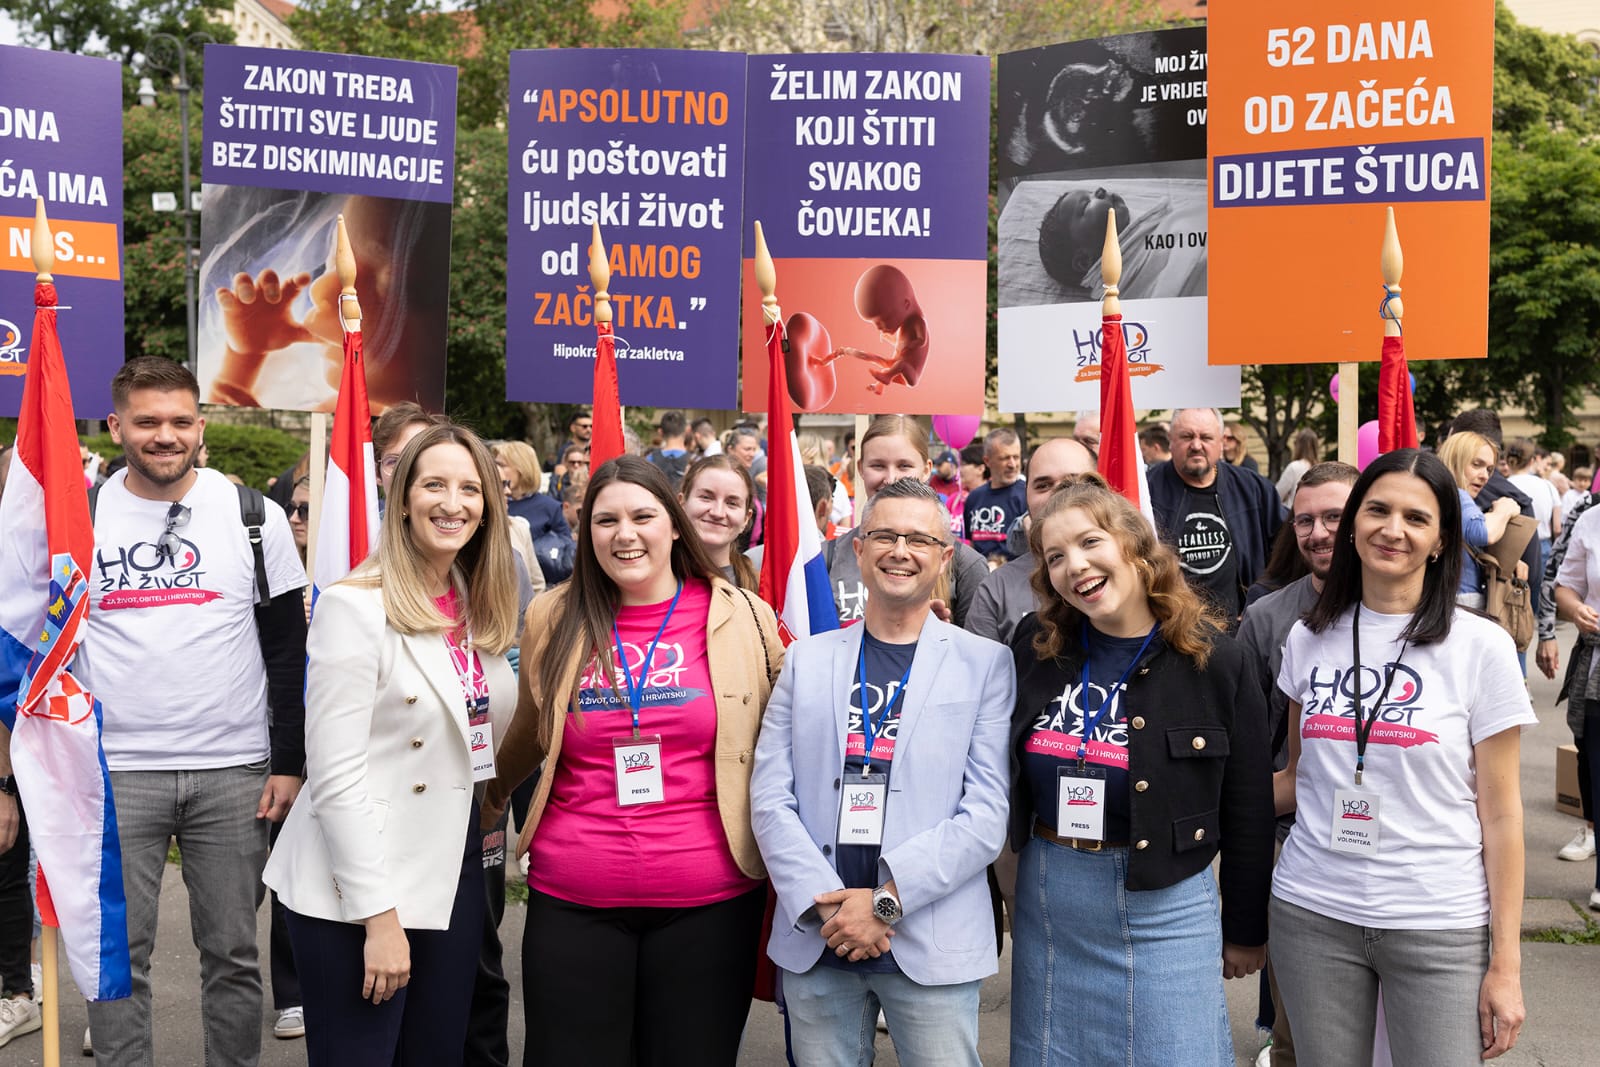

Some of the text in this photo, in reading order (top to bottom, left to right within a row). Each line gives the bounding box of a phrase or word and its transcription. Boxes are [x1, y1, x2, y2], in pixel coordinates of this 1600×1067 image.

[1267, 20, 1433, 68] 52 DANA
[1155, 55, 1186, 73] MOJ
[244, 65, 414, 104] ZAKON TREBA
[770, 63, 961, 102] ŽELIM ZAKON
[1140, 85, 1157, 102] JE
[219, 96, 438, 146] ŠTITITI SVE LJUDE
[1244, 77, 1455, 135] OD ZAČEĆA
[796, 108, 935, 146] KOJI ŠTITI
[212, 141, 444, 185] BEZ DISKIMINACIJE
[522, 140, 727, 181] ću poštovati
[808, 161, 921, 192] SVAKOG
[1219, 145, 1479, 201] DIJETE ŠTUCA
[48, 171, 108, 207] IMA
[524, 191, 724, 231] ljudski život
[798, 200, 931, 237] ČOVJEKA!
[9, 227, 105, 264] NS...
[1145, 233, 1175, 250] KAO
[1179, 233, 1183, 248] I
[541, 243, 702, 279] od AMOG
[533, 285, 707, 330] ZAČTKA.”
[629, 346, 685, 361] zakletva
[1186, 551, 1210, 562] JOSHUA
[100, 571, 206, 592] ZA ŽIVOT
[646, 691, 687, 701] HRVATSKU
[1310, 662, 1423, 707] HOD
[1033, 711, 1063, 732] ZA
[1305, 696, 1334, 716] ZA
[1373, 730, 1416, 739] HRVATSKU
[623, 752, 650, 768] HOD
[1067, 786, 1093, 799] HOD
[1342, 800, 1369, 811] HOD
[1342, 829, 1368, 838] VODITELJ
